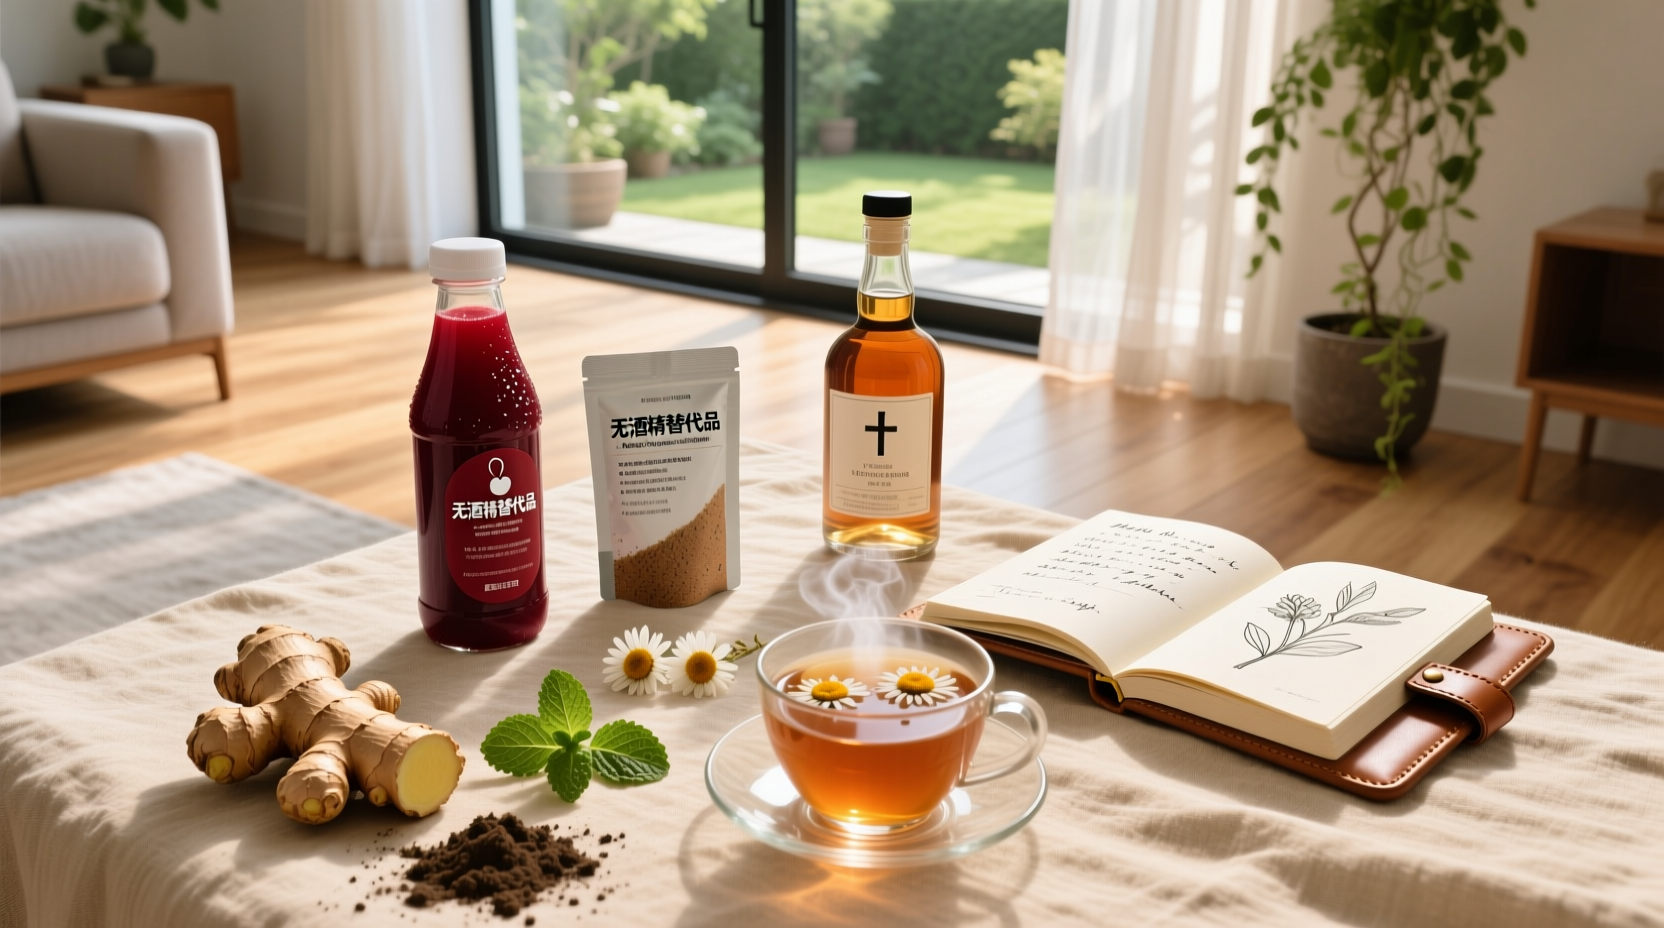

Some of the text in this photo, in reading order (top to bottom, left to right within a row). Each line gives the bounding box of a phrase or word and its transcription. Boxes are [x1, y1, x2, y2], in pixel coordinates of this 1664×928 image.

[610, 411, 720, 439] 无酒精替代品
